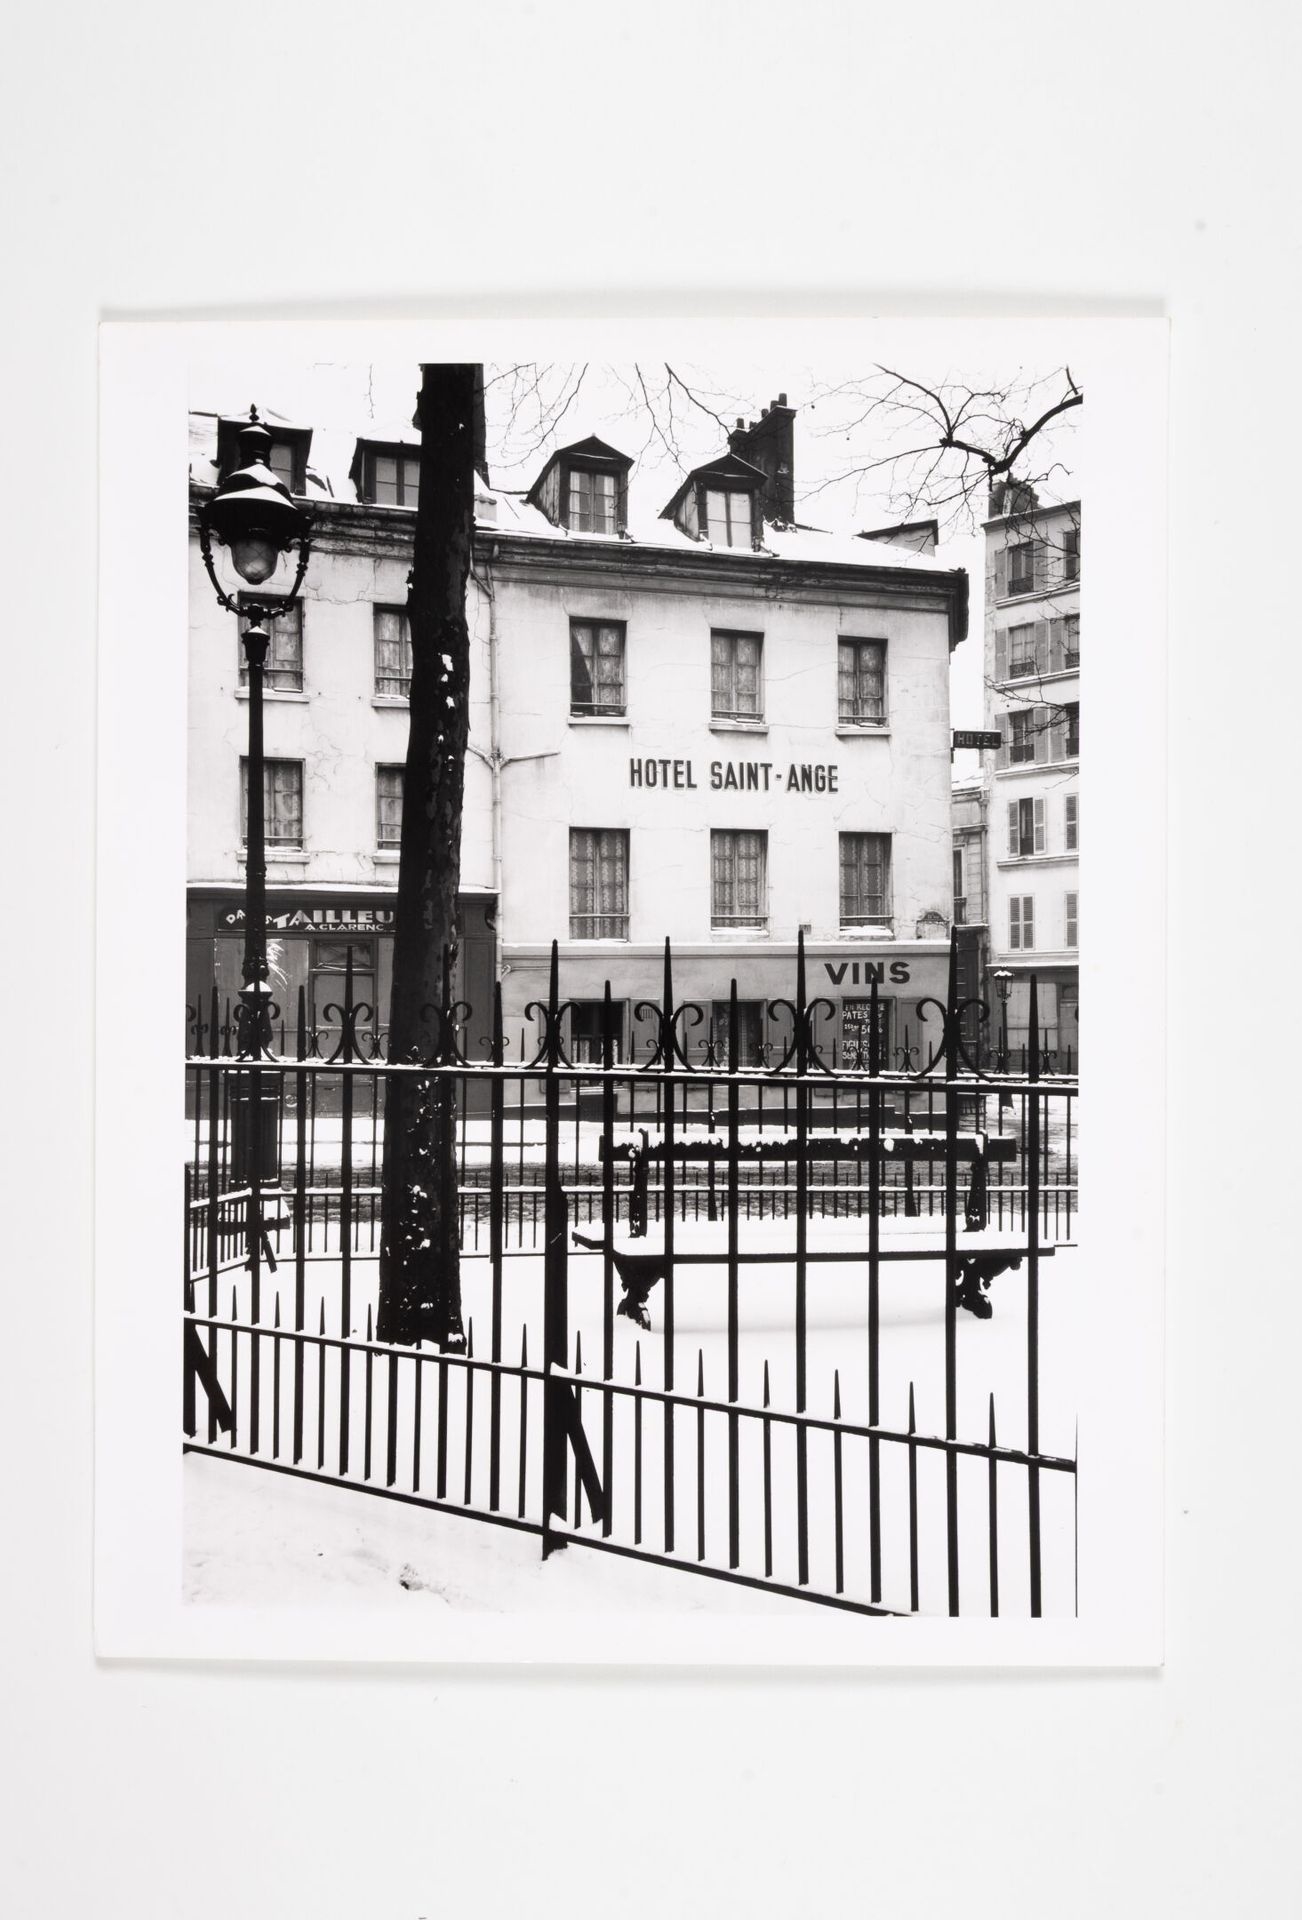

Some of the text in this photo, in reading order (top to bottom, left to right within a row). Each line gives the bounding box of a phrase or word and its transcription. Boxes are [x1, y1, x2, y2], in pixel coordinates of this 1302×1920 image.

[957, 733, 999, 746] HOTEL
[630, 758, 697, 789] HOTEL
[272, 909, 395, 930] TAILLEU
[824, 961, 910, 986] VINS
